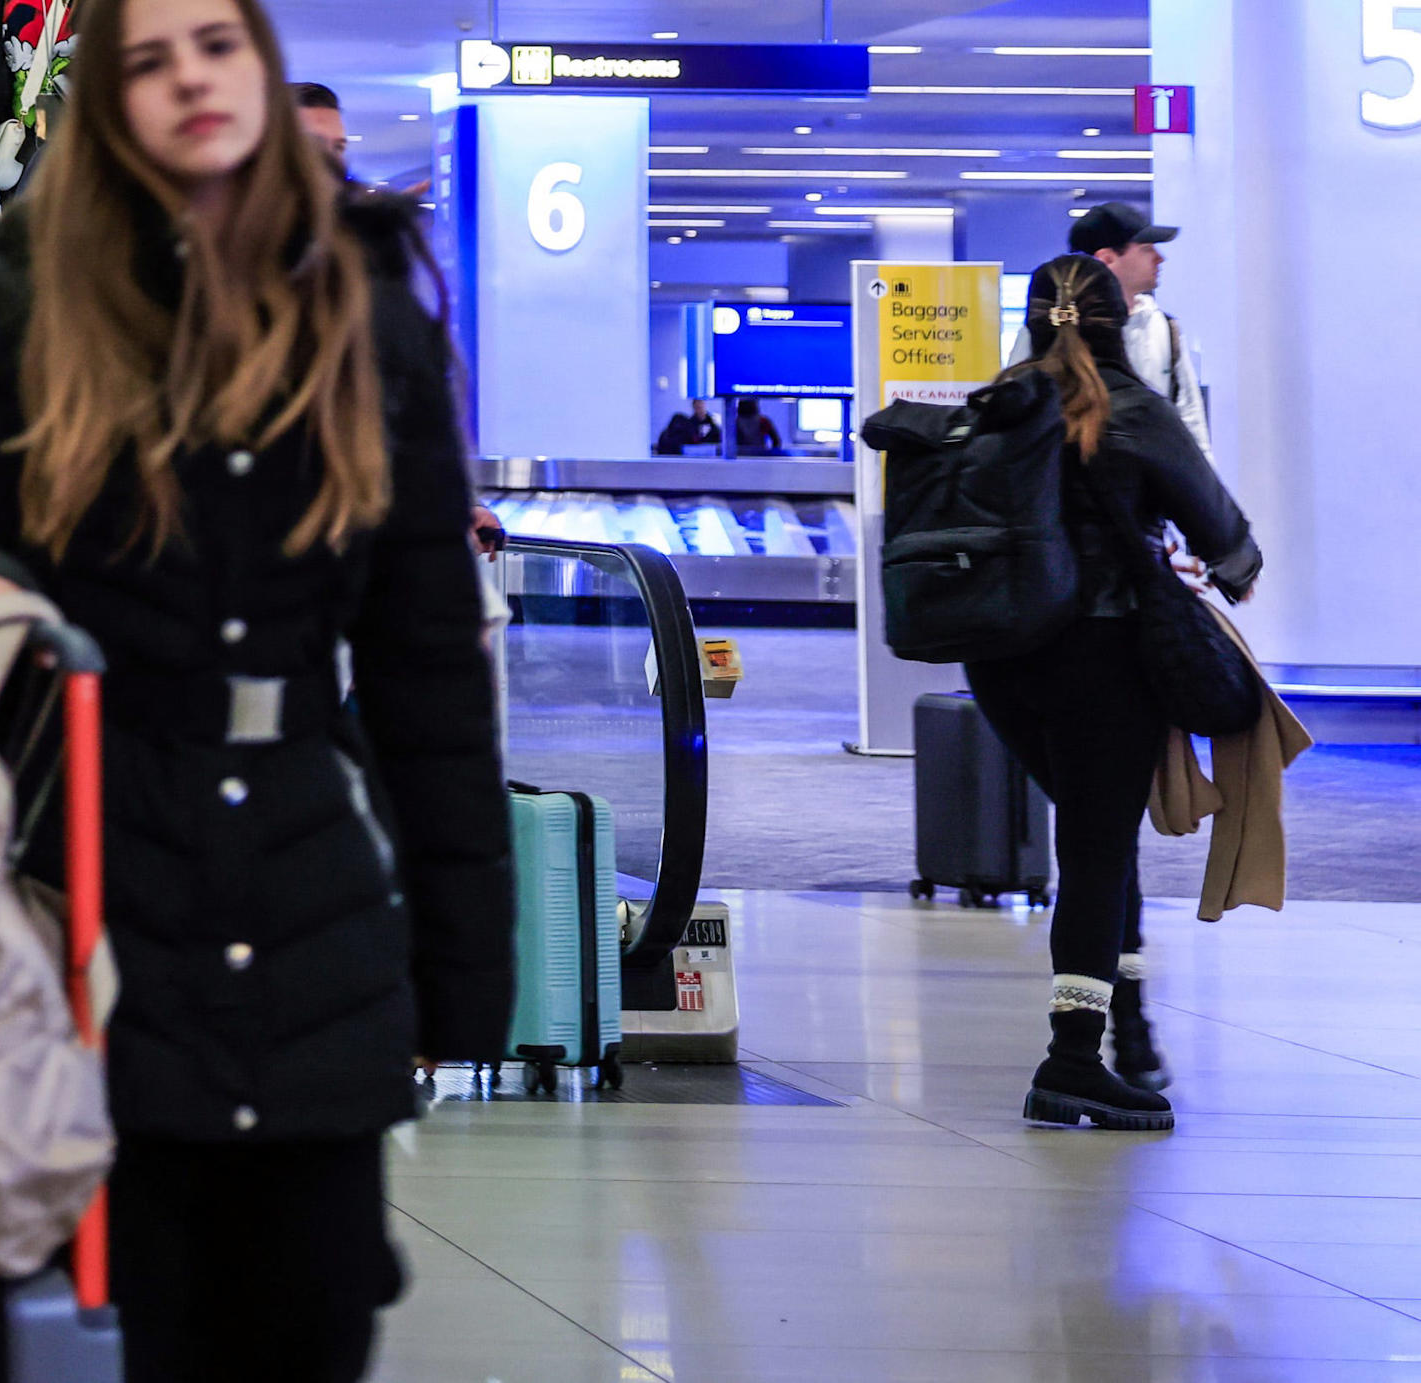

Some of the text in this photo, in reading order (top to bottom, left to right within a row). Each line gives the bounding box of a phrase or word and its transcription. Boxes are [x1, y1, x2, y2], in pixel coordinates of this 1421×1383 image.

[553, 54, 681, 78] Restrooms
[527, 161, 586, 252] 6
[891, 301, 969, 321] Baggage
[891, 324, 963, 342] Services
[892, 348, 956, 365] Offices
[891, 389, 966, 400] AIR CANAD
